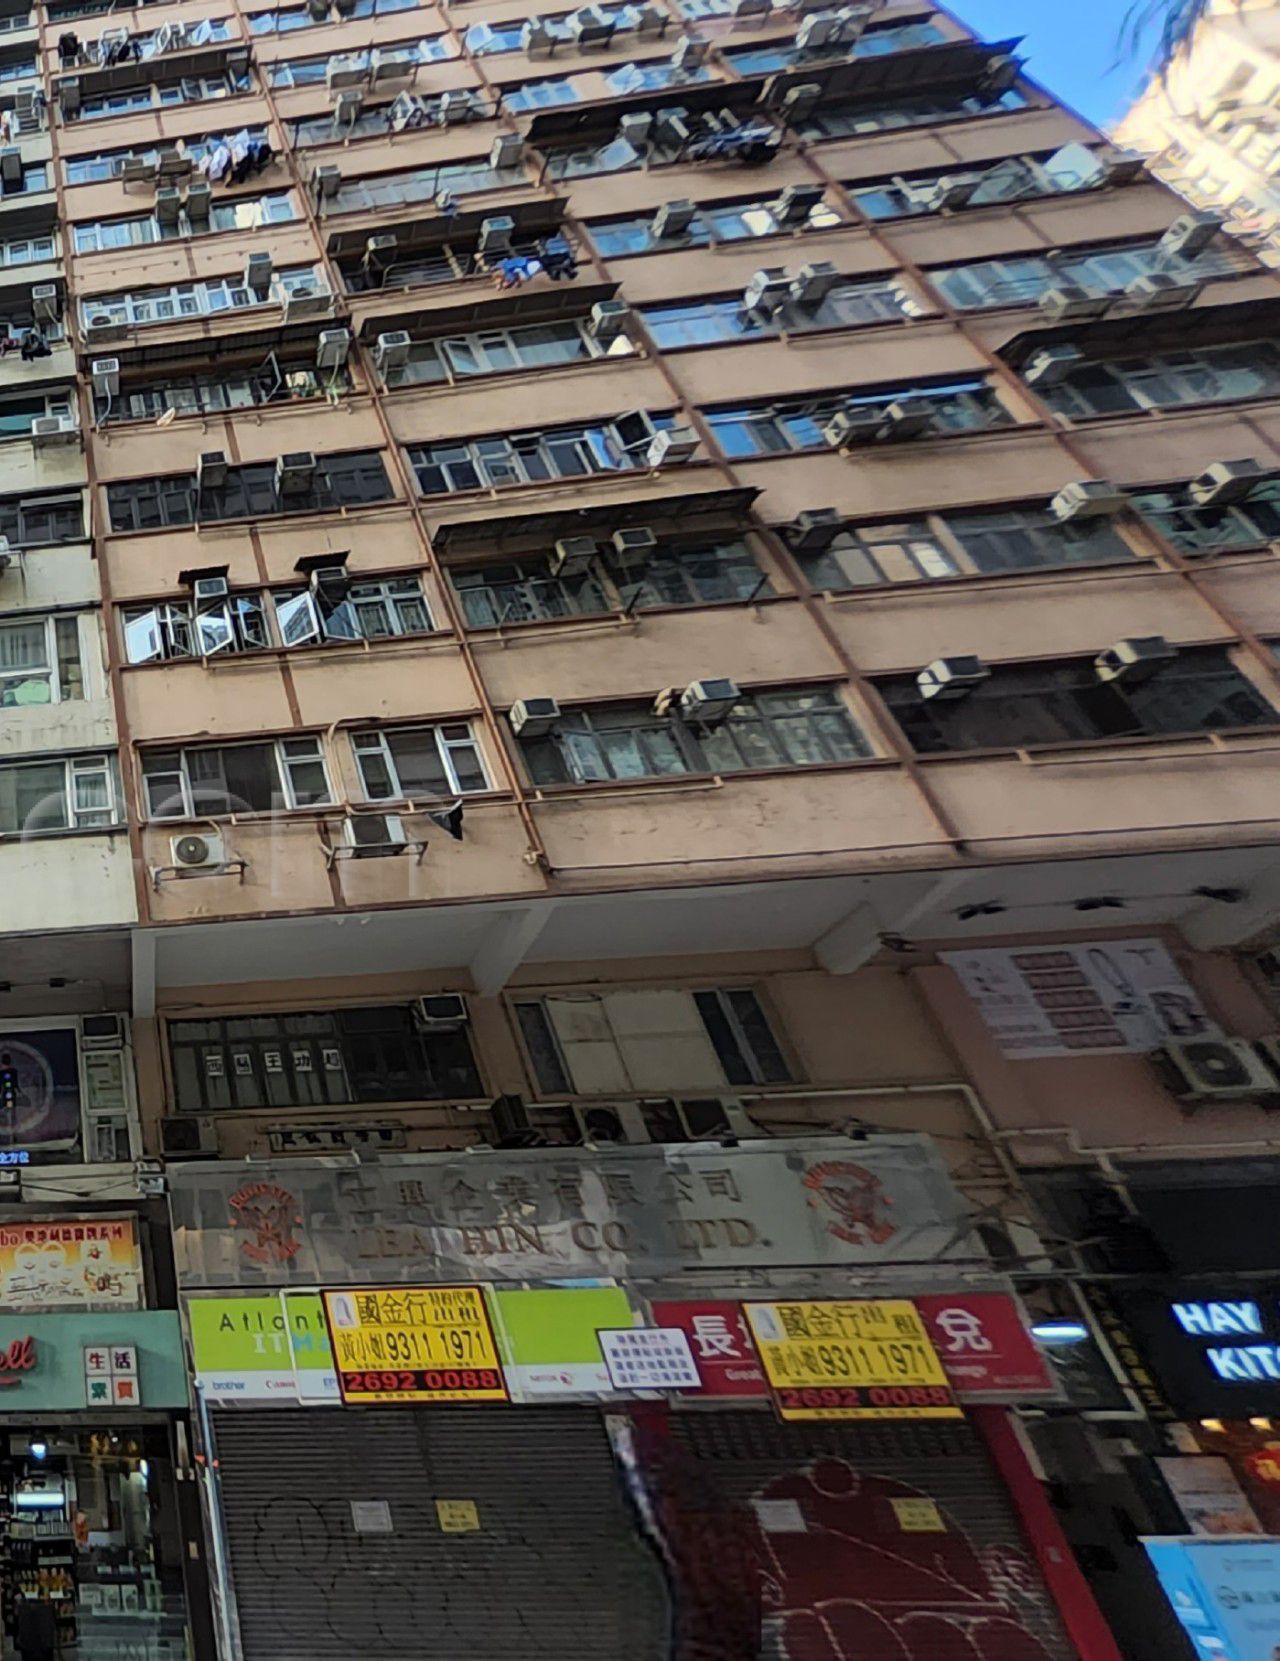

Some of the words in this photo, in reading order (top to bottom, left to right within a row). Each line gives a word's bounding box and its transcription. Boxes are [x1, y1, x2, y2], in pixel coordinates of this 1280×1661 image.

[1171, 1302, 1264, 1336] HAY
[386, 1330, 433, 1361] 9311
[439, 1329, 487, 1360] 1971
[818, 1344, 875, 1377] 9311
[877, 1343, 935, 1376] 1971
[1206, 1346, 1280, 1381] KIT
[345, 1371, 418, 1391] 2692
[423, 1370, 498, 1390] 0088
[781, 1387, 861, 1408] 2692
[867, 1386, 950, 1407] 0088
